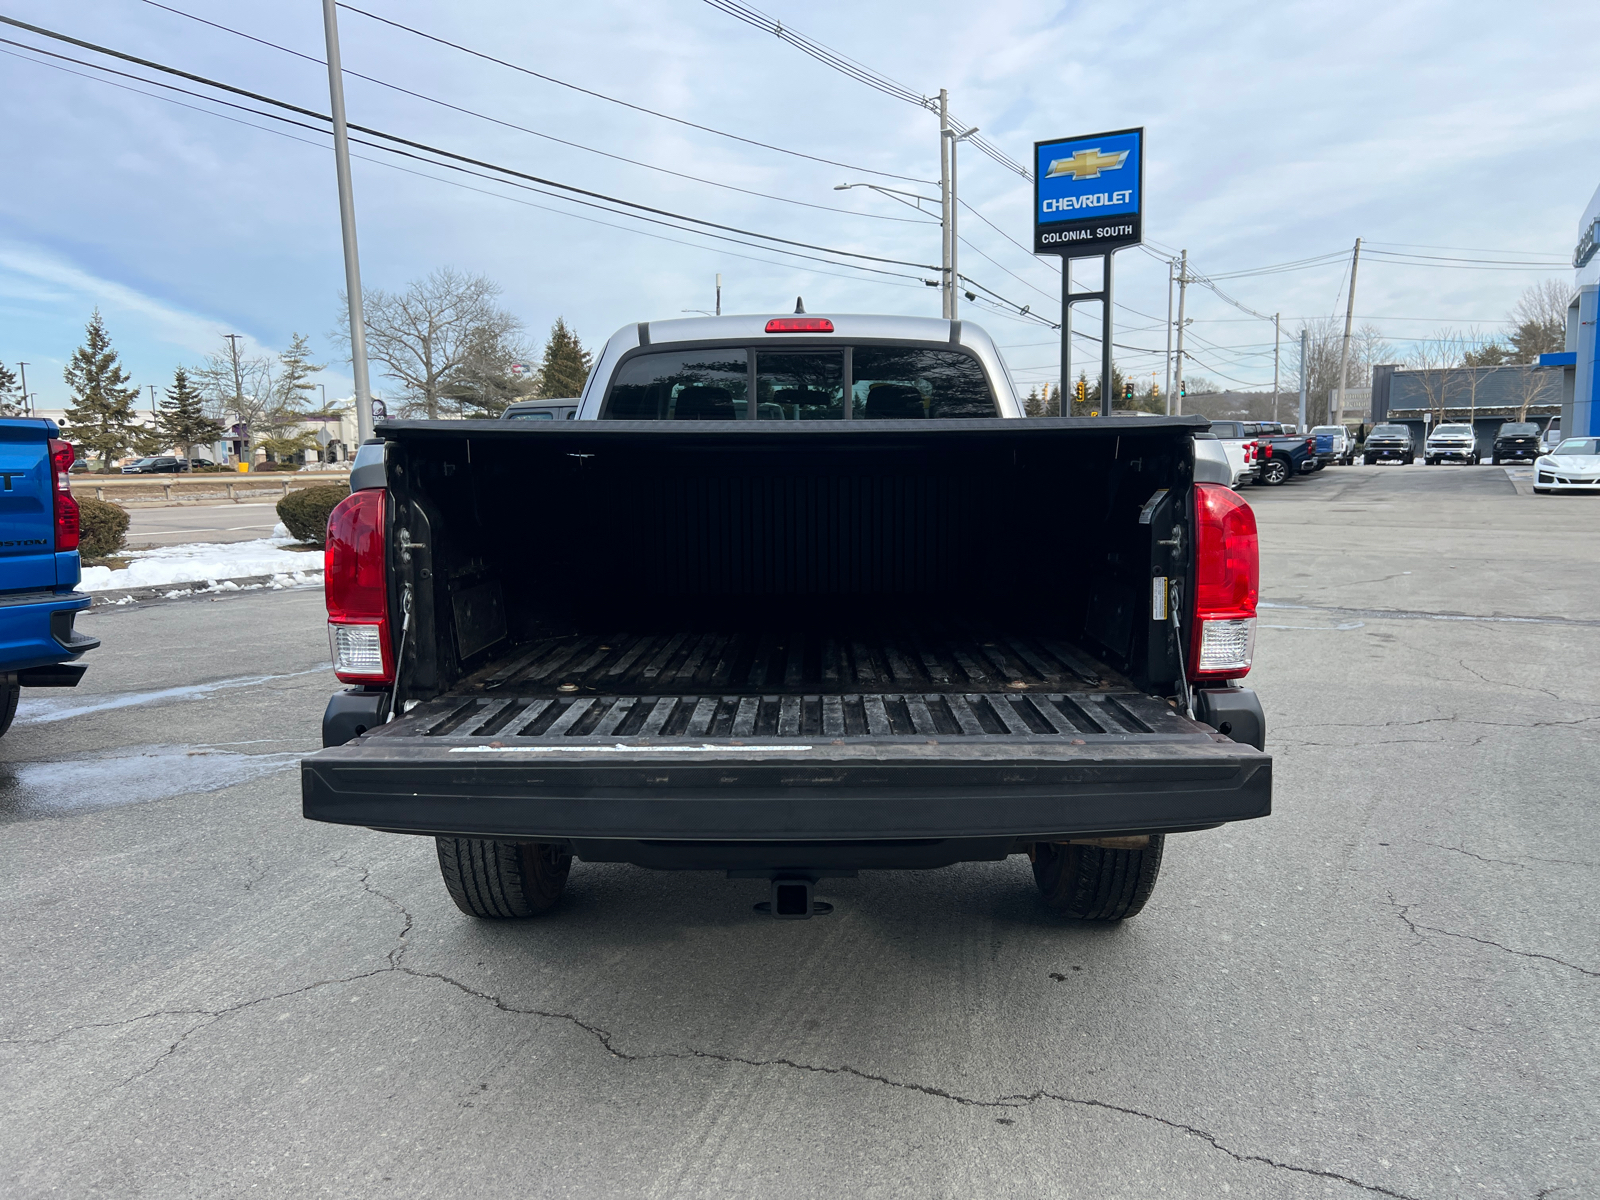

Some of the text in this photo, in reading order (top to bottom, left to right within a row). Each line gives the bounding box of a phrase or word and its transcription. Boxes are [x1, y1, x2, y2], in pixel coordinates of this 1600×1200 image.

[1042, 190, 1132, 213] CHEVROLET
[1041, 225, 1133, 243] COLONIAL SOUTH
